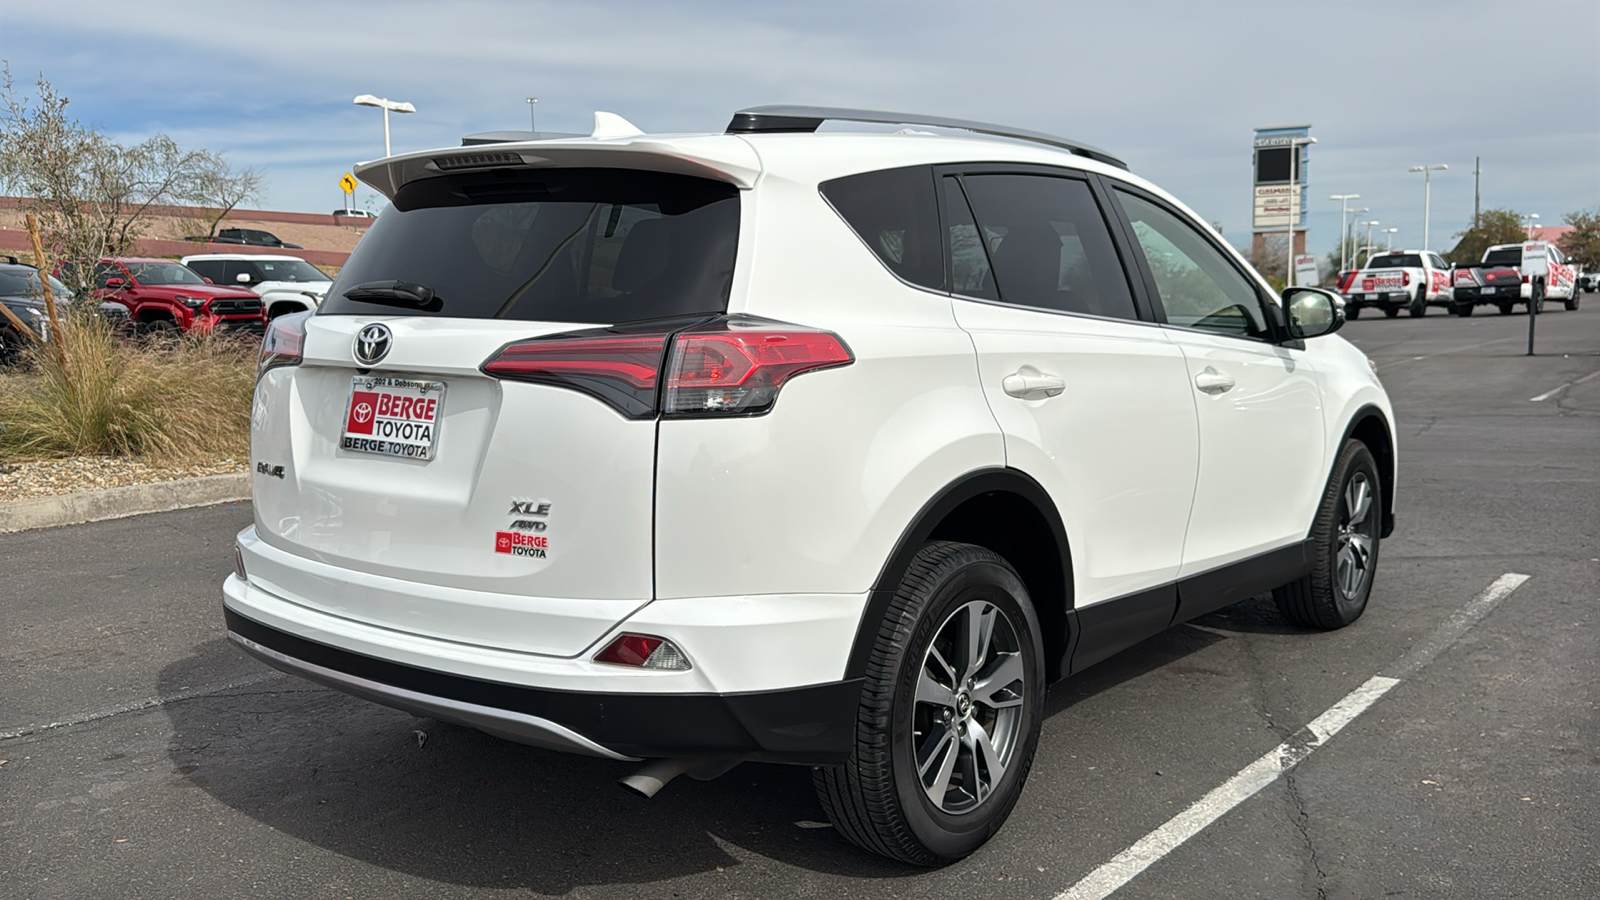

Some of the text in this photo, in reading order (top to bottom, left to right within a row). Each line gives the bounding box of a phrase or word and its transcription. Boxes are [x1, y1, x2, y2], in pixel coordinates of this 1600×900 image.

[1375, 277, 1401, 285] BERGE
[377, 393, 436, 420] BERGE
[375, 420, 431, 442] TOYOTA
[344, 437, 427, 458] BERGE TOYOTA
[507, 500, 552, 517] XLE
[509, 519, 547, 532] AWD
[512, 546, 546, 558] TOYOTA
